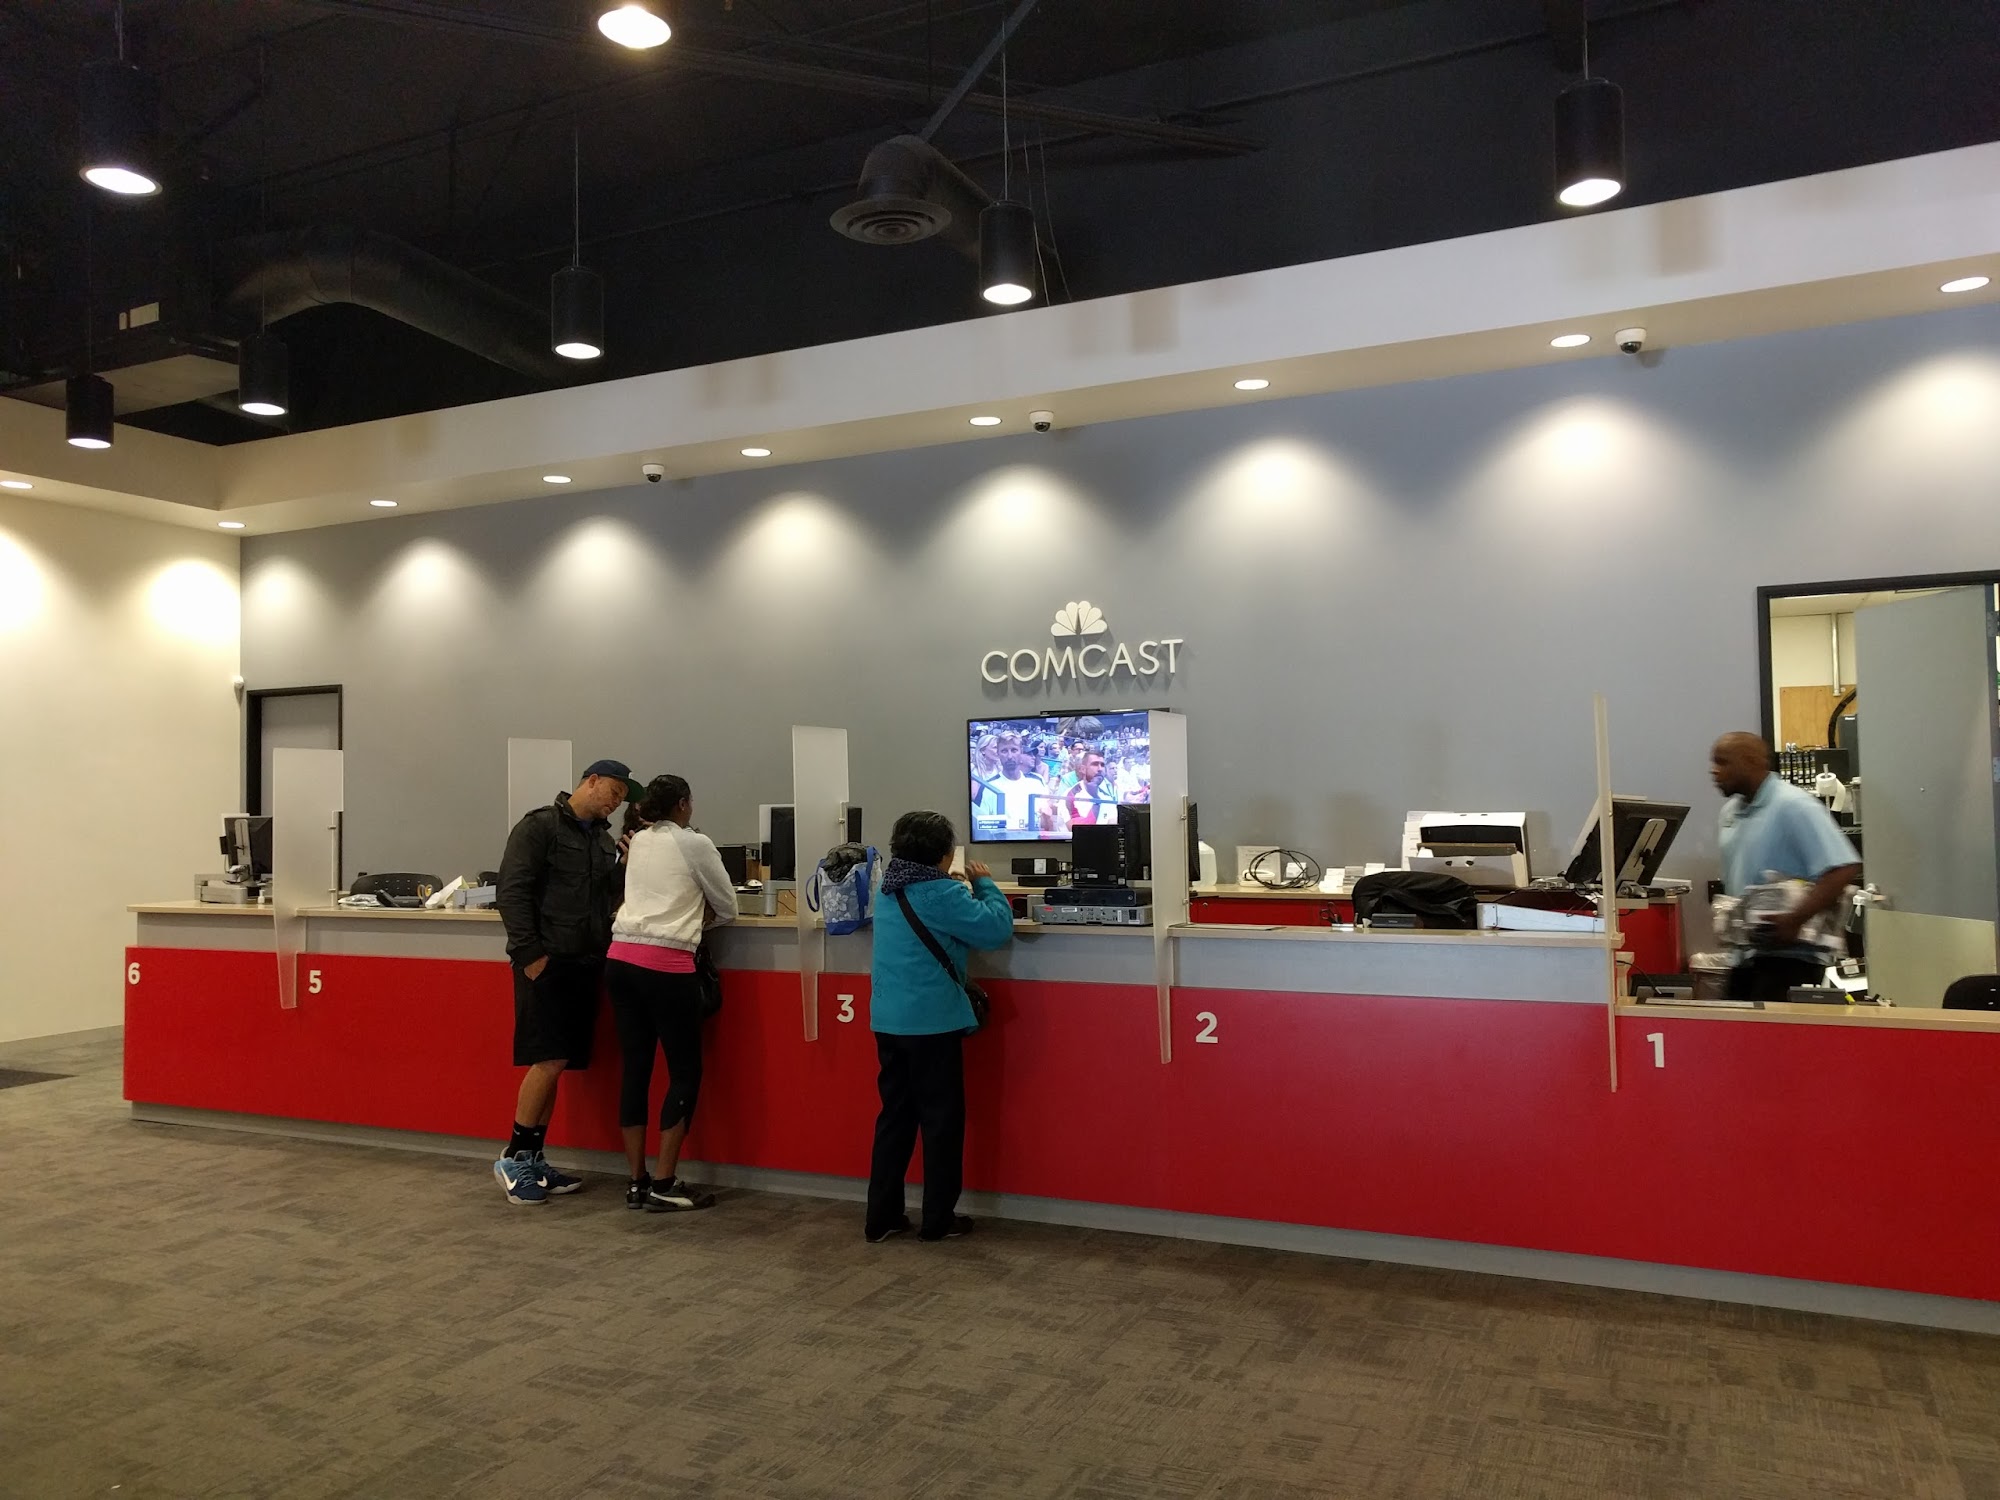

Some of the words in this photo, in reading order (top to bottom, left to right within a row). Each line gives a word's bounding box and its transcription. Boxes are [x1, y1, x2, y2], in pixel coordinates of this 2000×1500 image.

[981, 639, 1184, 683] COMCAST
[127, 962, 140, 985] 6
[308, 970, 322, 994] 5
[836, 994, 855, 1023] 3
[1195, 1011, 1219, 1044] 2
[1647, 1032, 1665, 1068] 1
